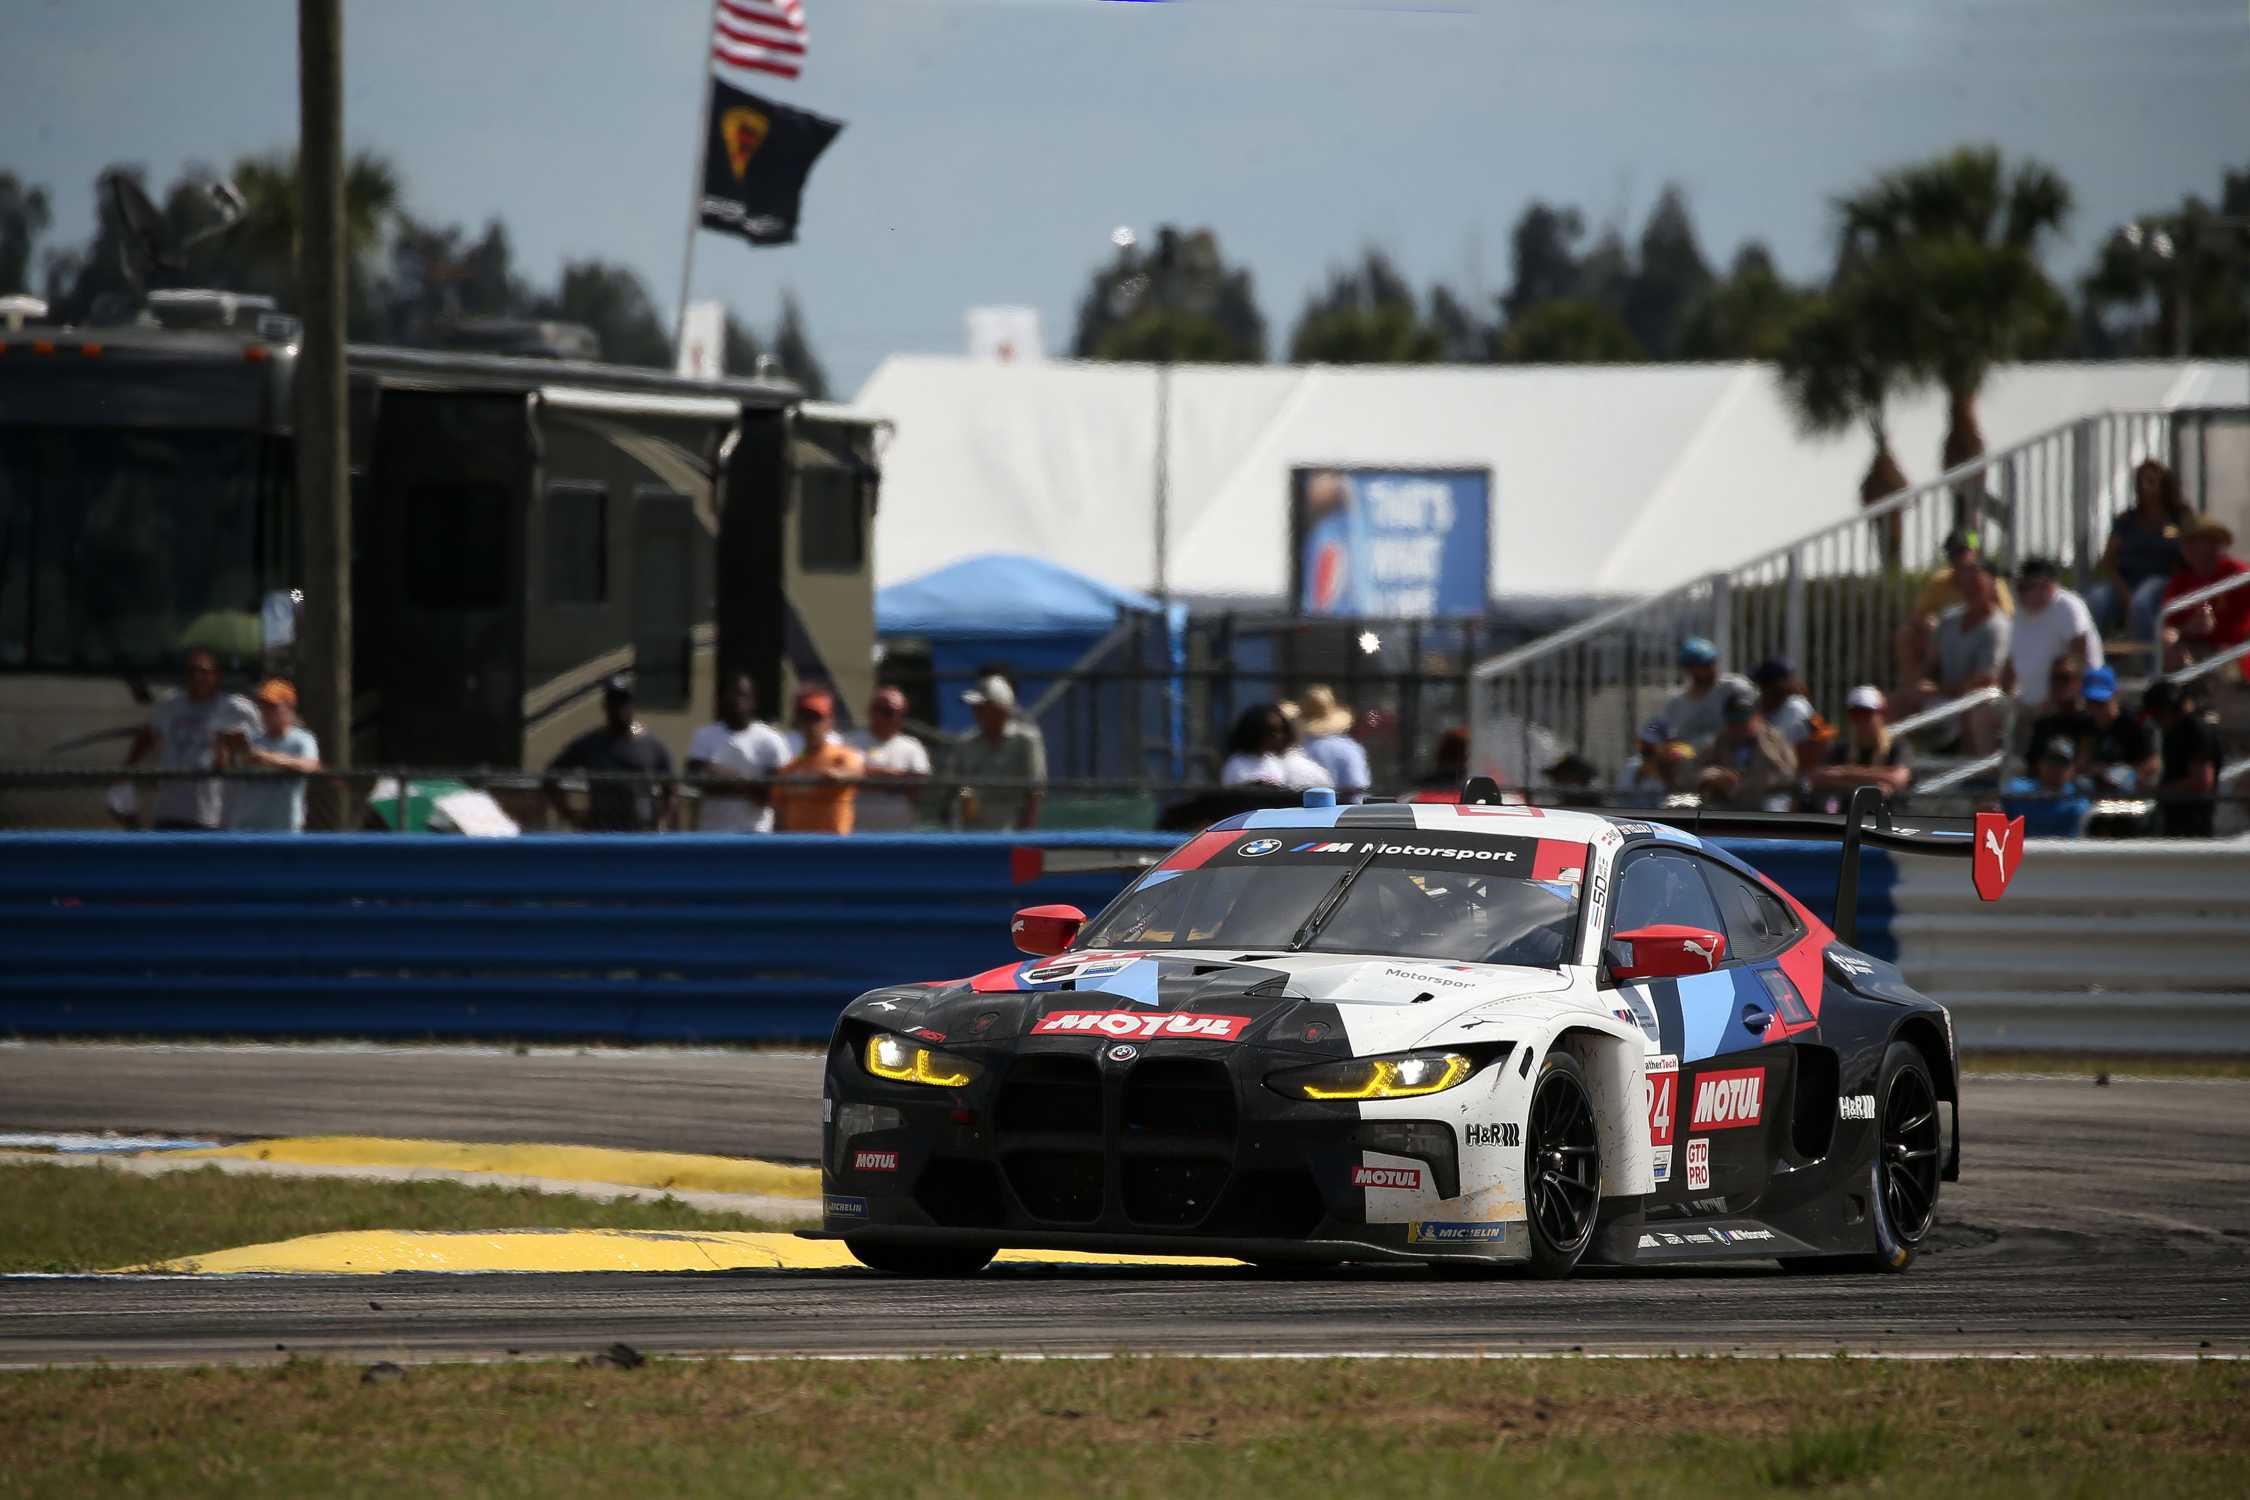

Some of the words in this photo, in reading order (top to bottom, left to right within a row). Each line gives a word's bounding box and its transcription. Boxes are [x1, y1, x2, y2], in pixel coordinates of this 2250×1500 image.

[1360, 842, 1517, 862] Motorsport
[1042, 1013, 1233, 1036] MOTUL
[1645, 1059, 1677, 1070] atherTech
[1693, 1077, 1761, 1124] MOTUL
[855, 1153, 897, 1169] MOTUL
[1688, 1143, 1707, 1163] GTD
[1355, 1169, 1418, 1186] MOTUL
[1689, 1165, 1708, 1185] PRO
